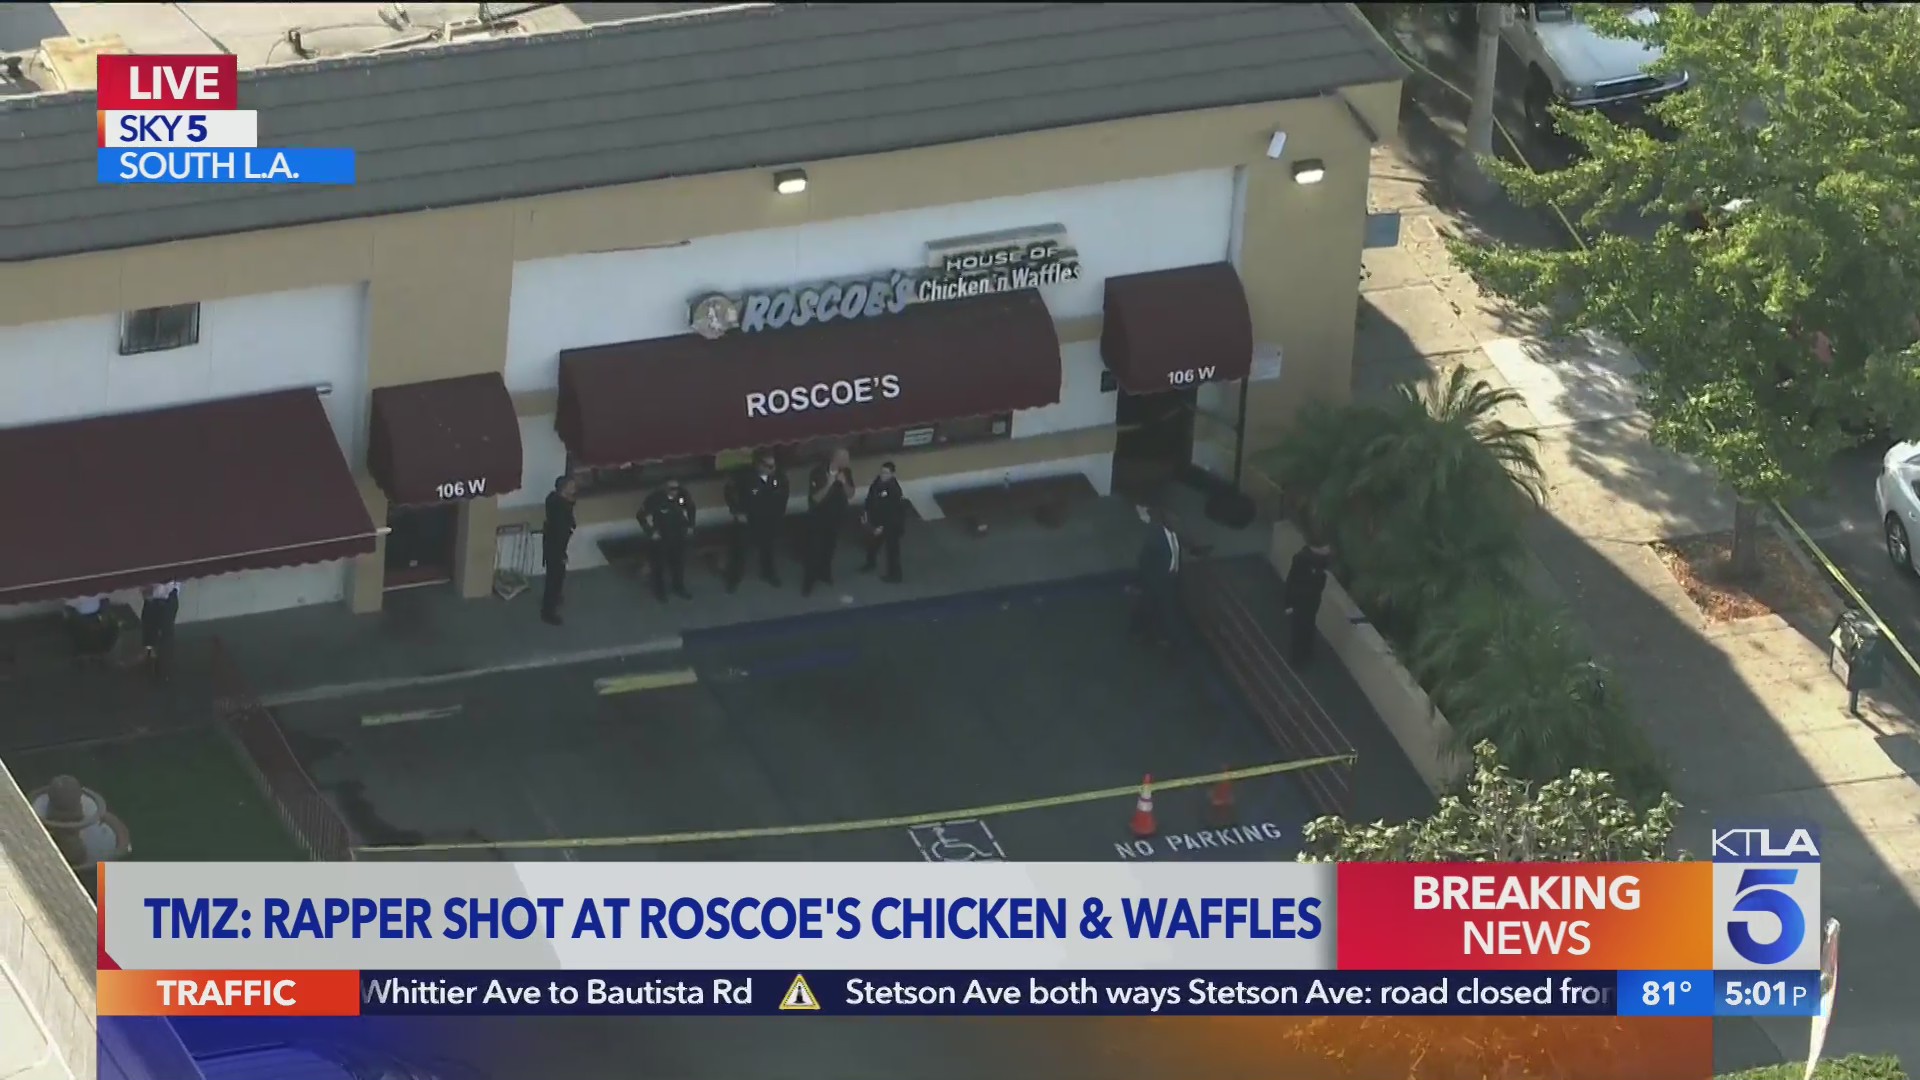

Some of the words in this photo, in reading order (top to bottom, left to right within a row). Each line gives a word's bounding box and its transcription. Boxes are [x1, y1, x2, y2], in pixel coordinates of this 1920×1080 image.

[946, 252, 1023, 271] HOUSE
[1030, 246, 1058, 260] OF
[918, 277, 990, 302] Chicken
[1012, 262, 1083, 289] Waffles
[741, 272, 916, 333] ROSCOE'S
[1168, 368, 1194, 385] 106
[1197, 365, 1216, 380] W
[746, 375, 901, 418] ROSCOE'S
[435, 481, 465, 499] 106
[467, 477, 486, 495] W
[1113, 839, 1155, 861] NO
[1164, 821, 1282, 853] PARKING
